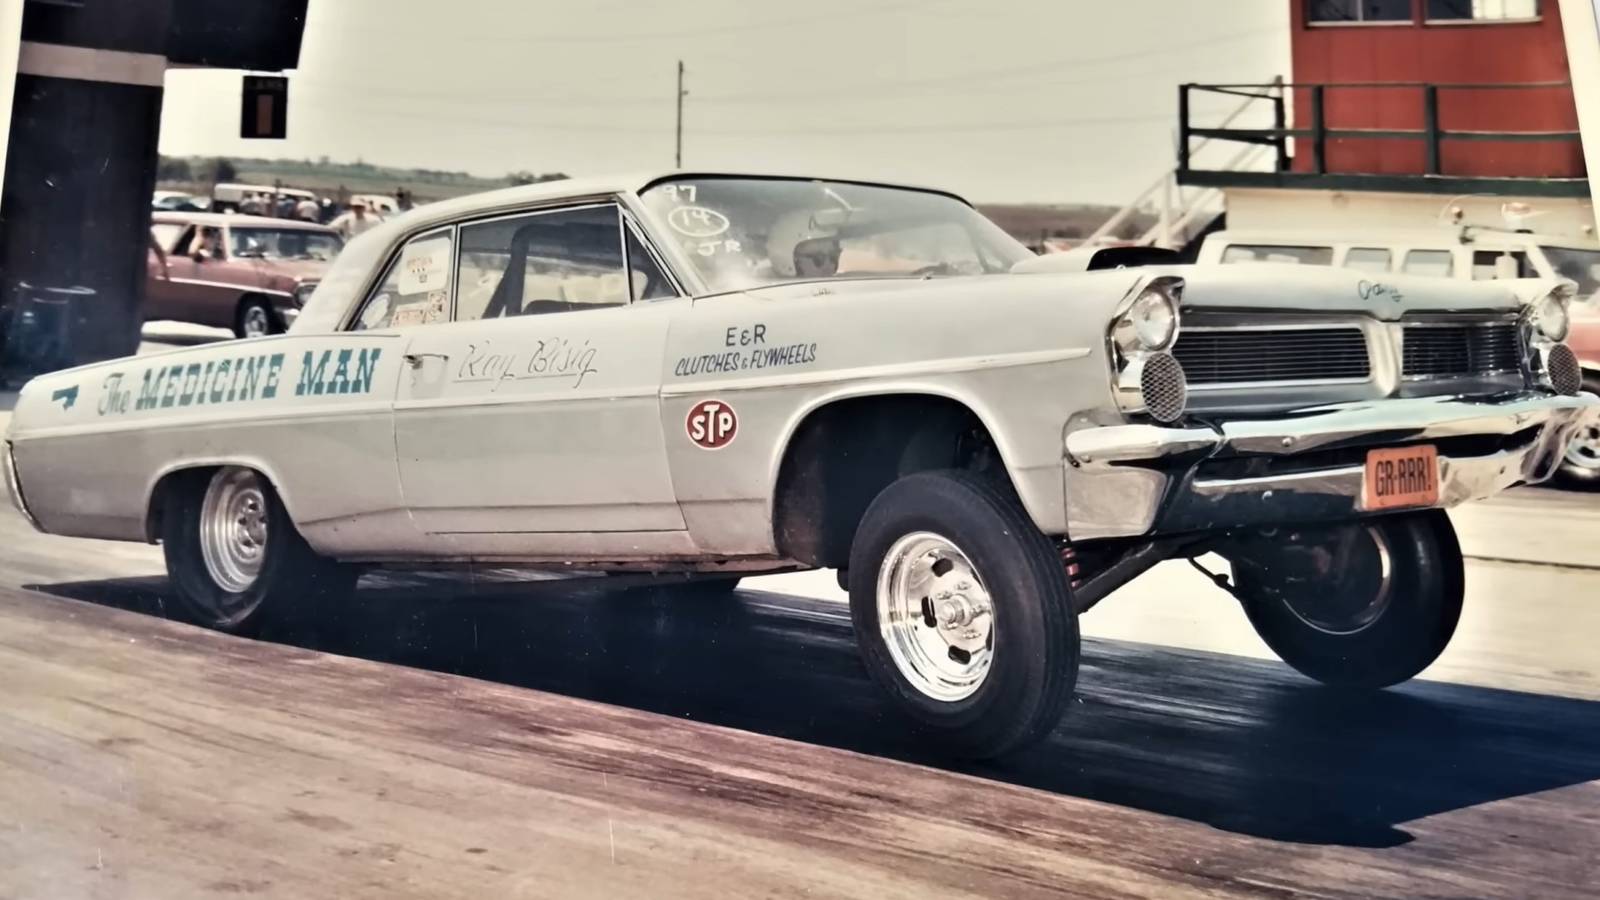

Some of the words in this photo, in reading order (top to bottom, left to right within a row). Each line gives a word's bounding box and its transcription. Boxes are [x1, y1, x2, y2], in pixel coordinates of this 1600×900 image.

[135, 353, 285, 411] MEDICINE
[295, 348, 382, 396] MAN
[458, 340, 515, 392] Ray
[675, 350, 740, 376] CLUTCHES
[749, 343, 817, 370] FLYWHEELS
[692, 404, 733, 442] STP
[1375, 456, 1432, 497] GR-RRR!
